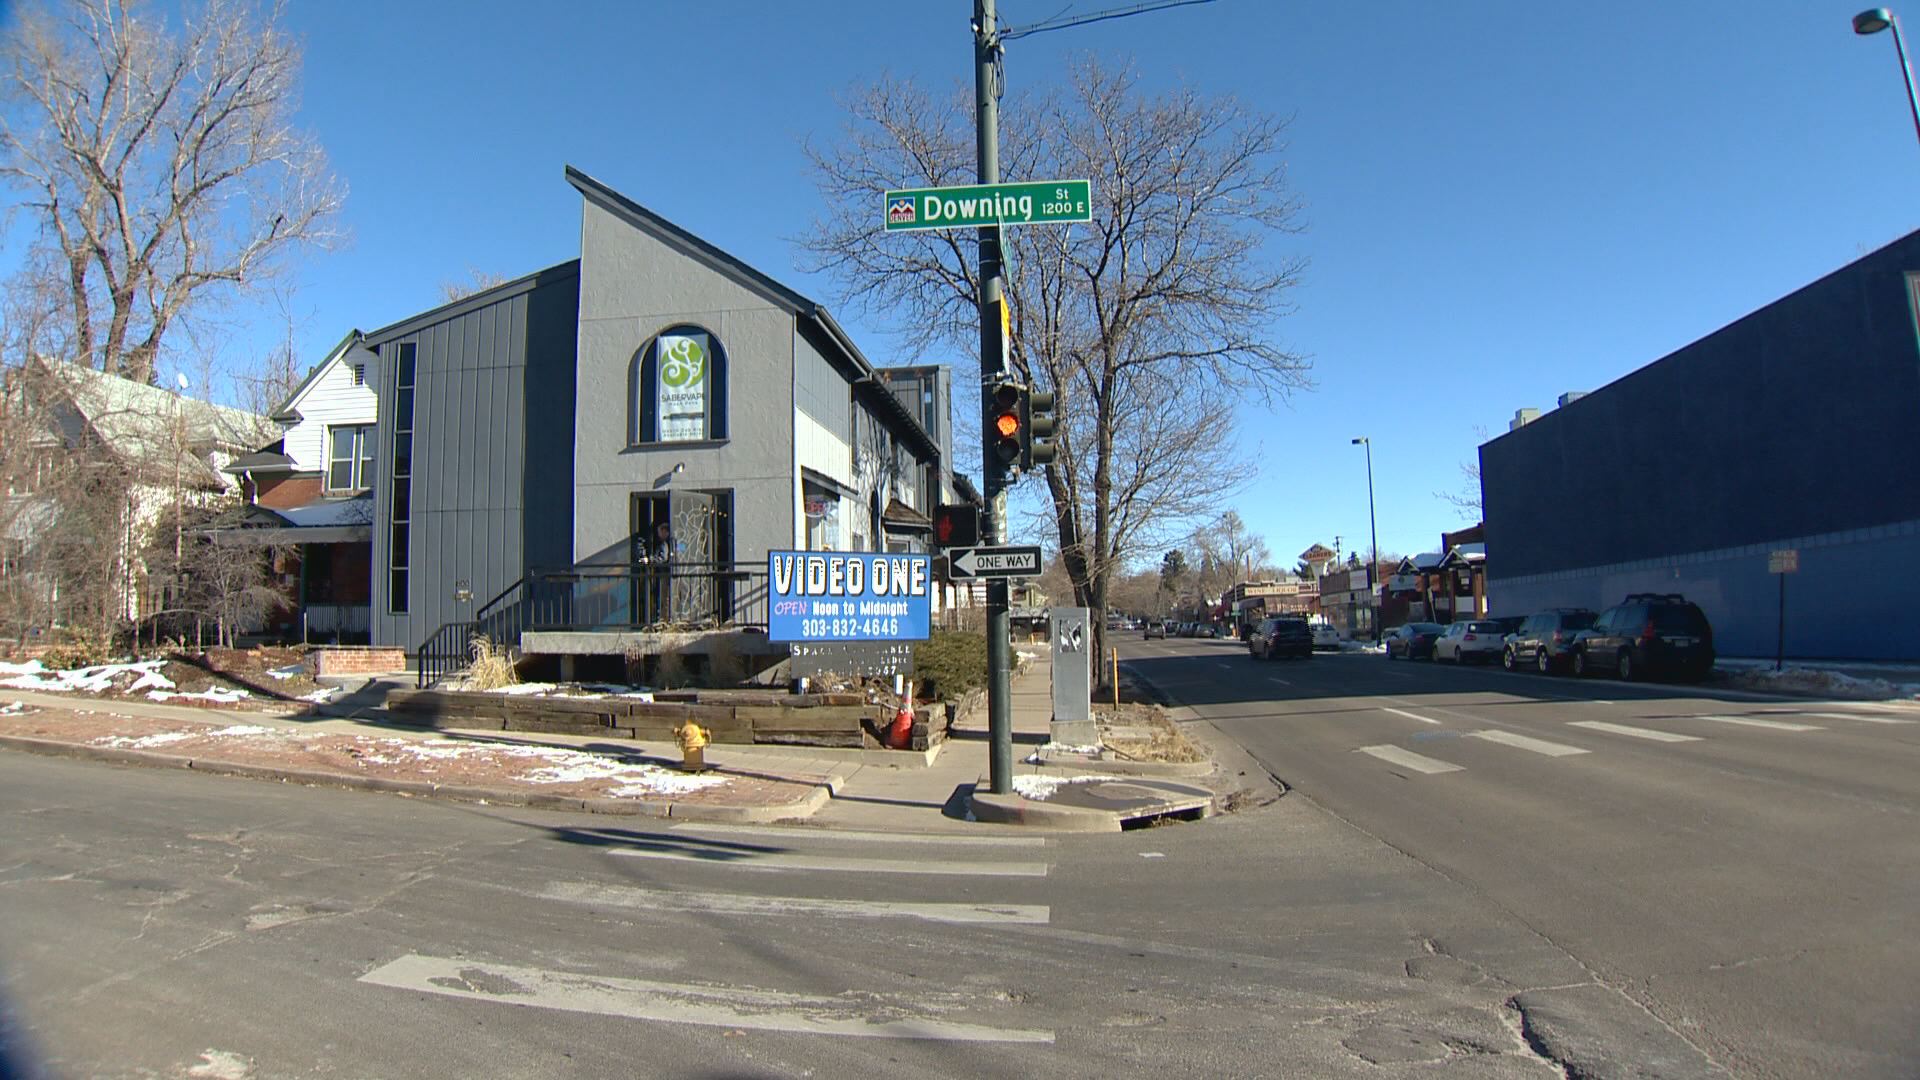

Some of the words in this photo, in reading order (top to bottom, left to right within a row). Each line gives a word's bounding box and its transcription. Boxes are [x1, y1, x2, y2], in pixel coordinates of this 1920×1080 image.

[1055, 188, 1069, 200] St
[924, 192, 1032, 221] Downing
[1041, 202, 1072, 215] 1200
[1076, 201, 1085, 213] E
[890, 211, 914, 223] DENVER
[977, 556, 1001, 568] ONE
[1006, 554, 1031, 566] WAY
[773, 555, 864, 596] VIDEO
[871, 558, 926, 596] ONE
[774, 601, 807, 615] OPEN
[812, 601, 839, 616] Noon
[842, 601, 855, 616] to
[859, 601, 909, 617] Midnight
[802, 618, 898, 637] 303-832-4646
